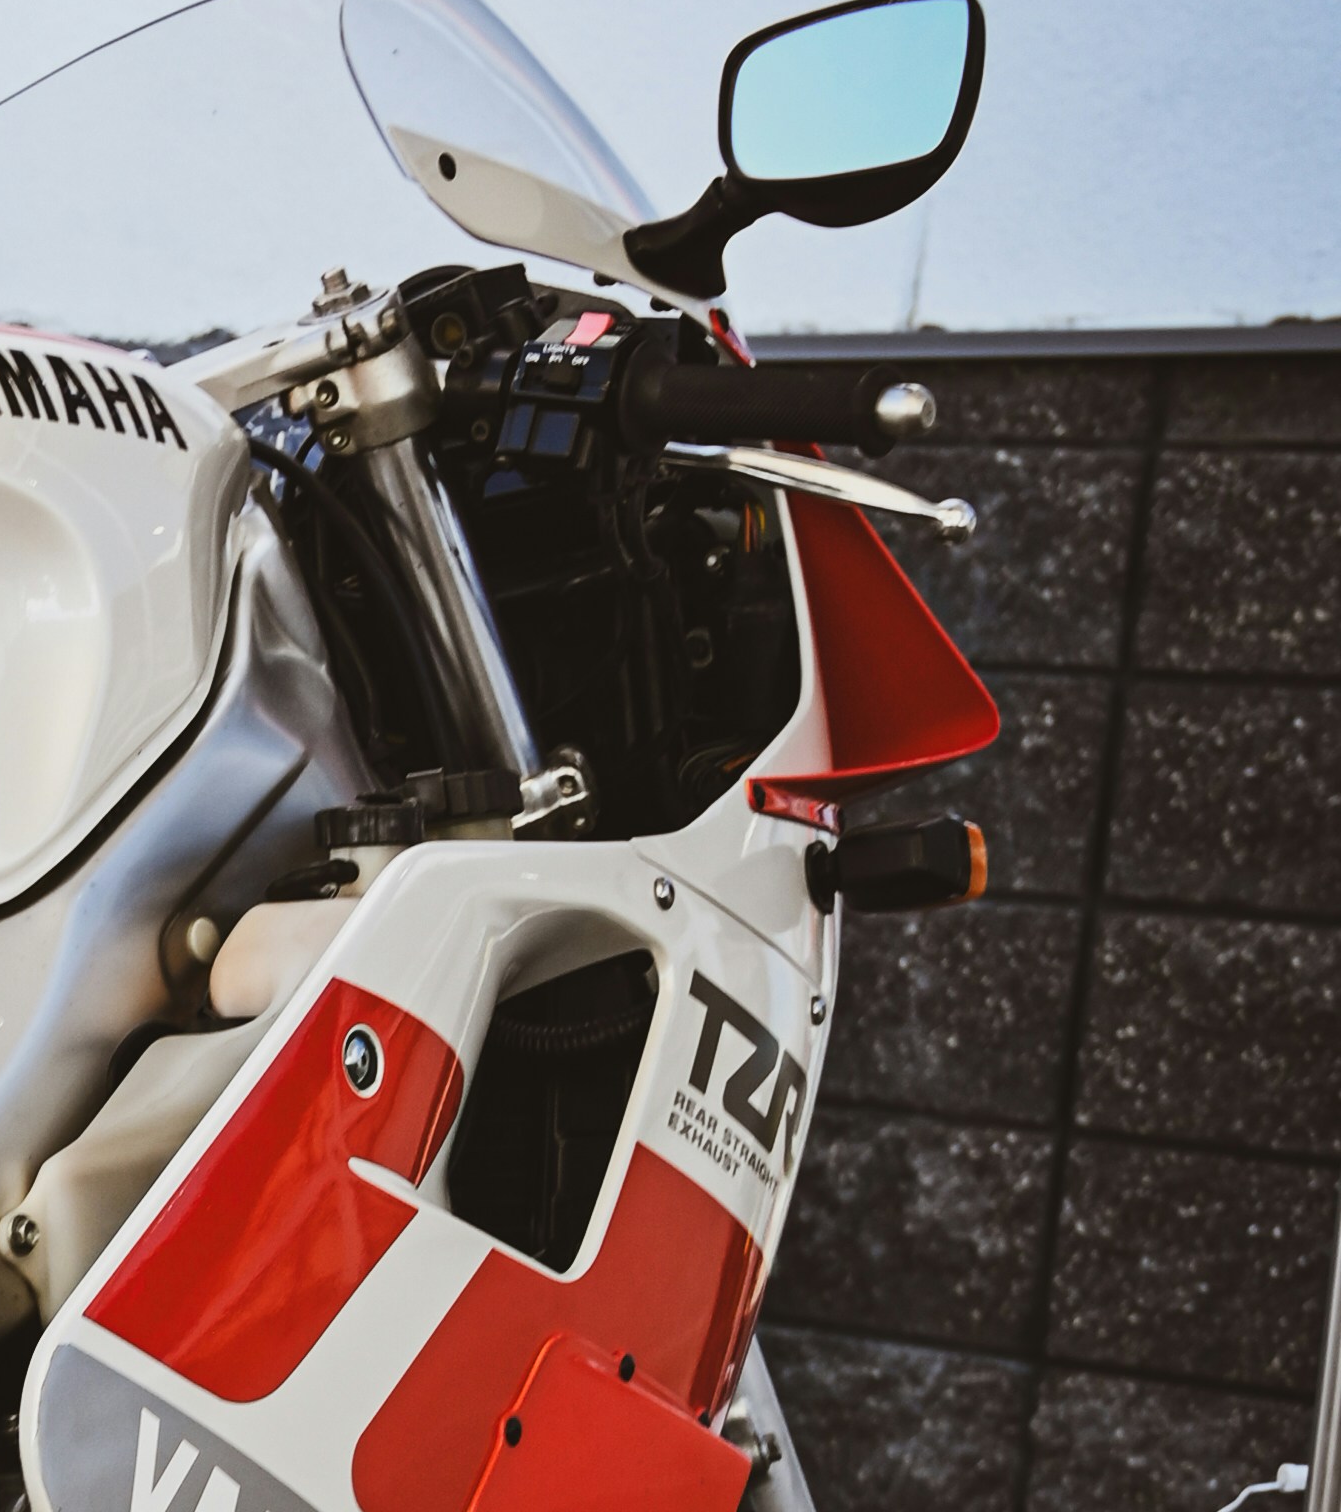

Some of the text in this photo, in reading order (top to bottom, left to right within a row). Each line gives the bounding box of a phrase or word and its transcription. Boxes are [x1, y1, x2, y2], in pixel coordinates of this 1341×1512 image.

[688, 968, 808, 1178] TZR
[667, 1111, 742, 1178] EXHAUST
[673, 1090, 780, 1194] REAR STRAIGHT
